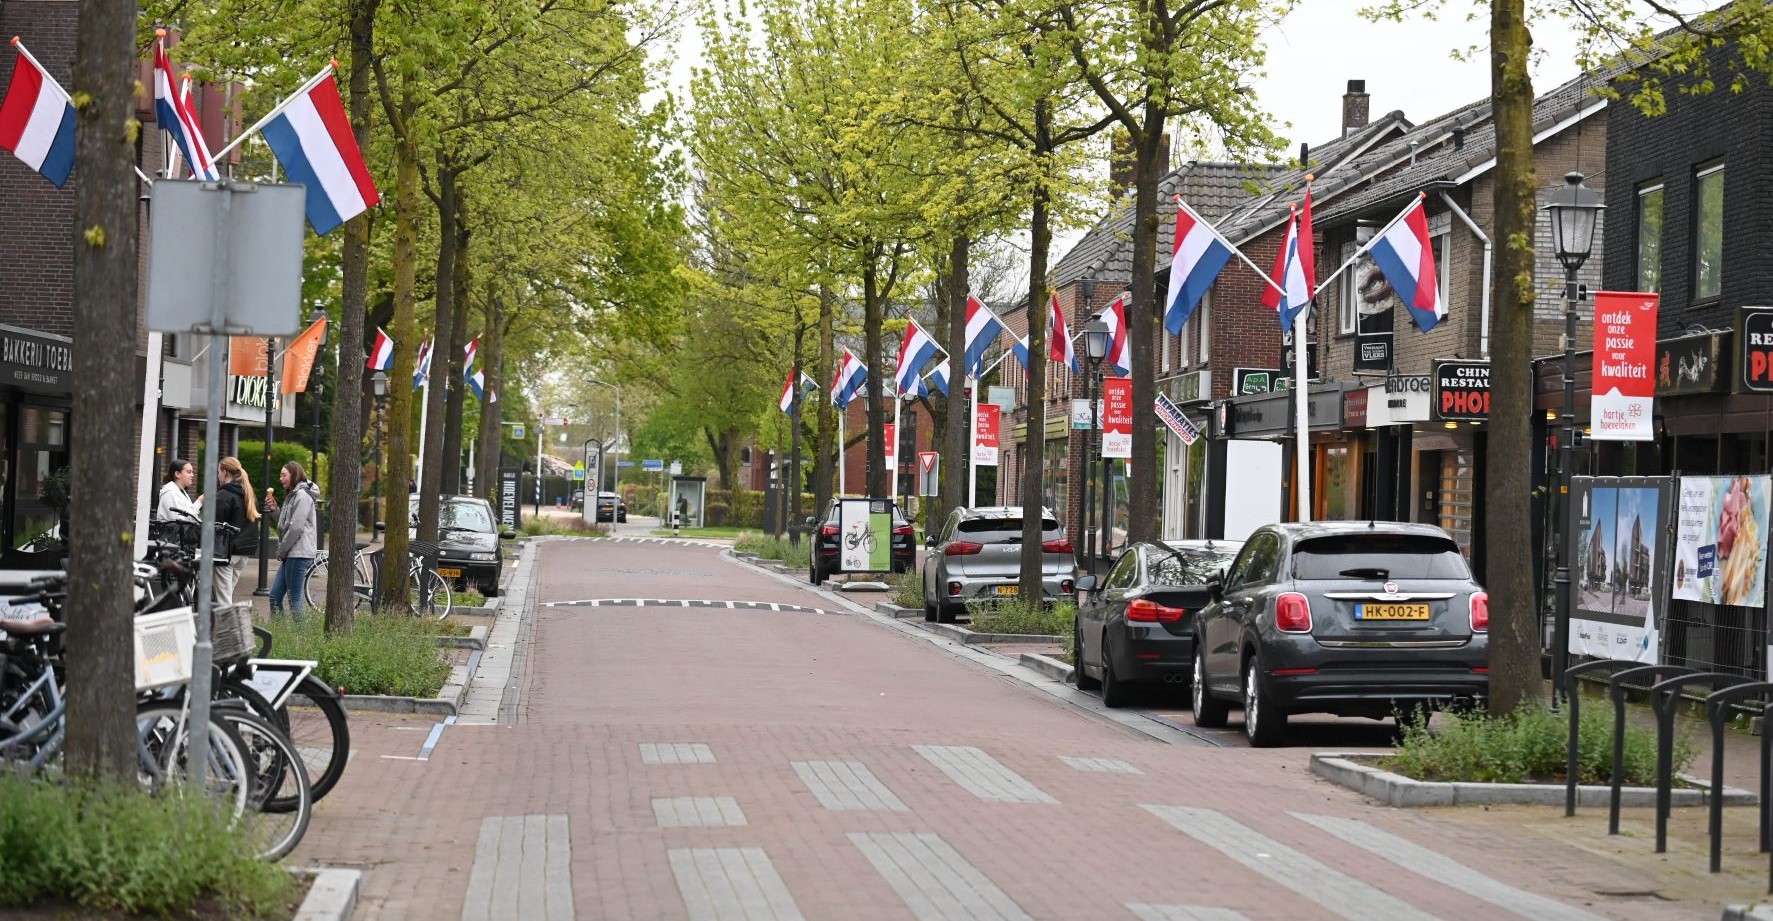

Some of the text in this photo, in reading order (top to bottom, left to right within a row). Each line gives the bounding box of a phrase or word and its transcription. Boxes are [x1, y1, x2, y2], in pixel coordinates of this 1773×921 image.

[1601, 311, 1632, 325] ontdek
[1607, 325, 1626, 334] onze
[1605, 335, 1634, 351] passie
[4, 336, 73, 372] BAKKERIJ TOEBA
[1611, 352, 1626, 360] voor
[296, 339, 318, 388] blokker
[1601, 359, 1647, 379] kwaliteit
[1456, 367, 1490, 377] CHIN
[236, 375, 280, 409] blokkr
[1157, 396, 1199, 439] REPARATIES
[1603, 408, 1625, 424] hartje
[1365, 605, 1425, 618] HK-002-F
